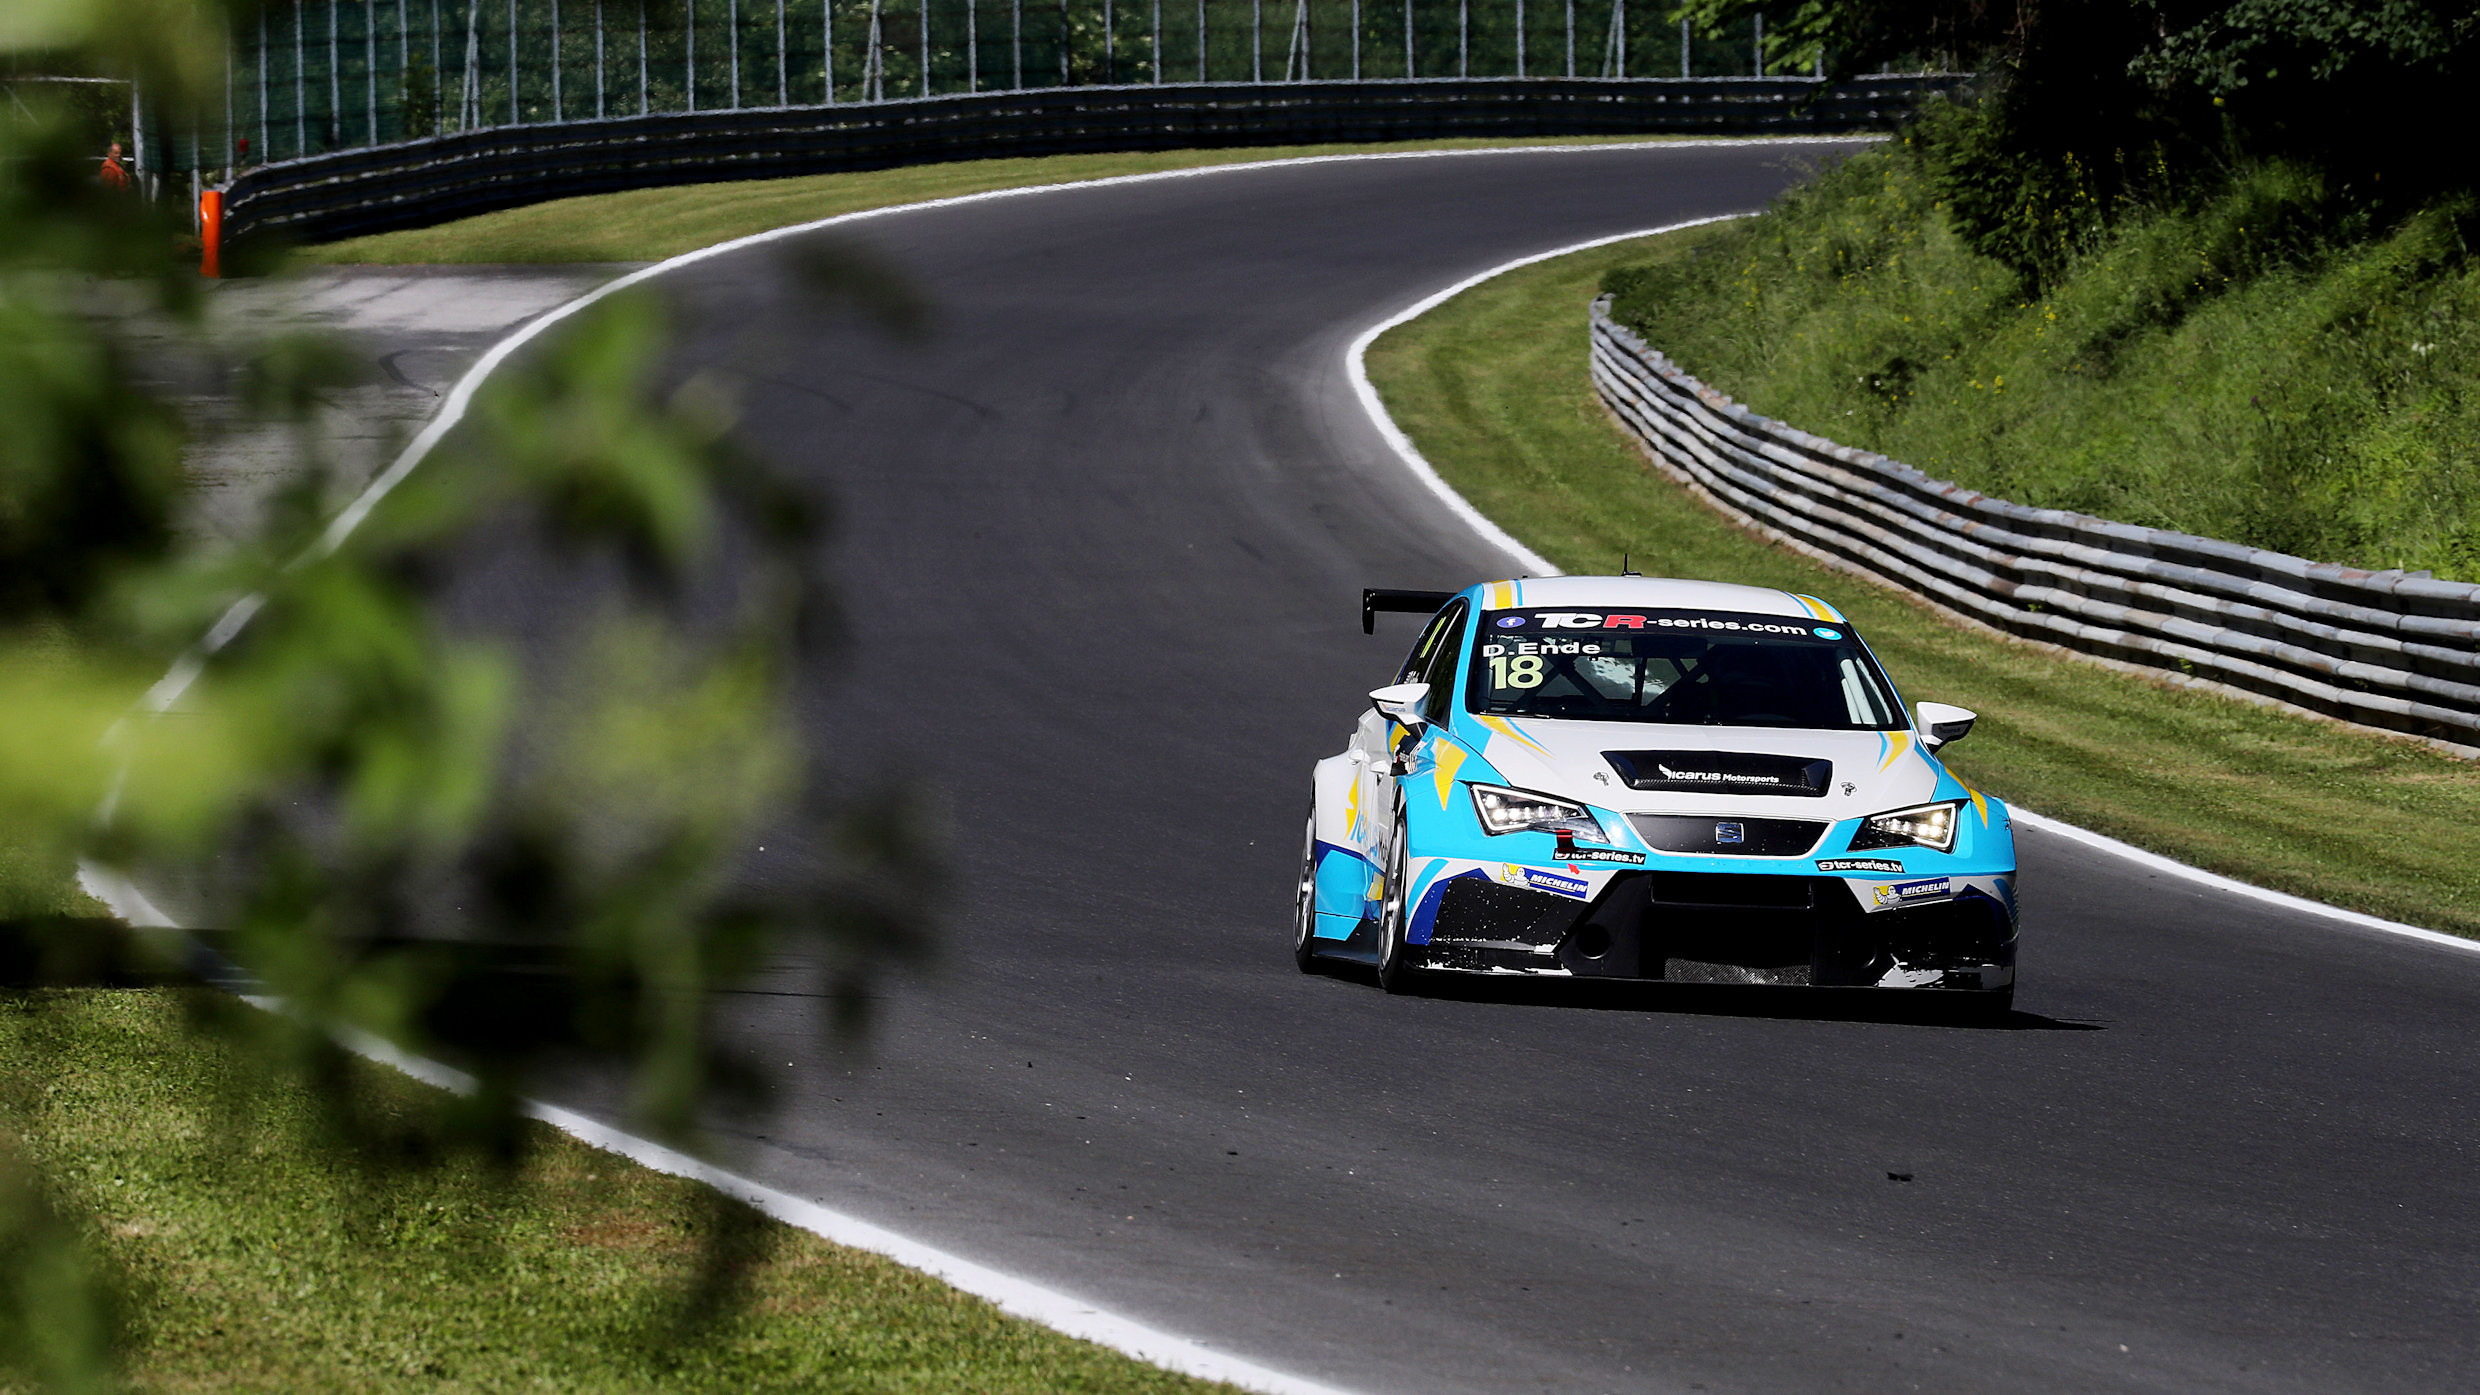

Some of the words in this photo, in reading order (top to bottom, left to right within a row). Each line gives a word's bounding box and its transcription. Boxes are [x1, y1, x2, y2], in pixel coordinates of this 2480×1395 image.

[1489, 655, 1544, 690] 18
[1723, 774, 1780, 783] Motorsports
[1834, 860, 1903, 872] tcr-series.tv
[1530, 874, 1588, 893] MICHELIN
[1902, 881, 1950, 896] MICHELIN
